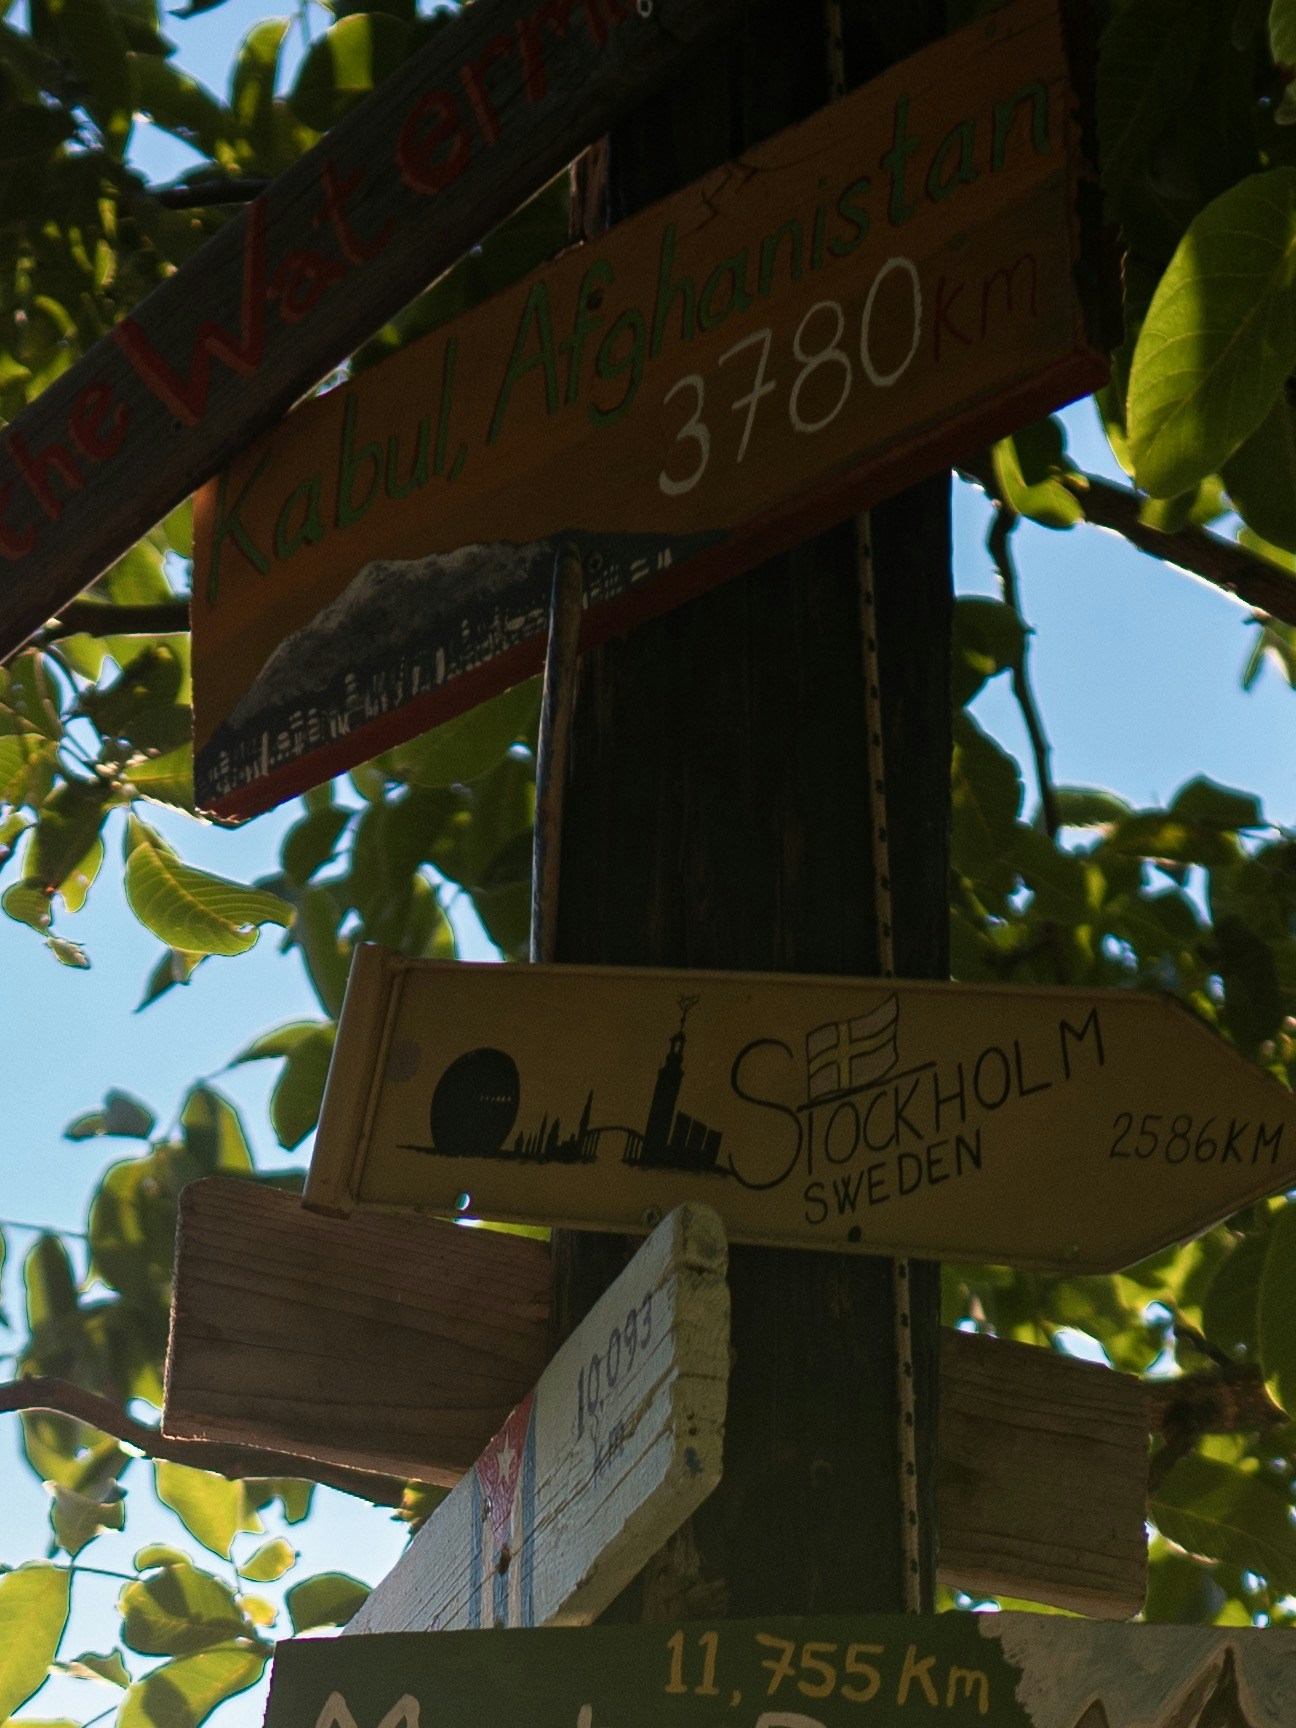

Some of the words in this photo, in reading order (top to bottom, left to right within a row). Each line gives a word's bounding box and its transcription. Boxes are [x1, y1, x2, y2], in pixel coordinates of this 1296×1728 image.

[488, 79, 1051, 447] Afghanistan
[657, 256, 922, 497] 3780
[804, 1129, 984, 1226] SWEDEN
